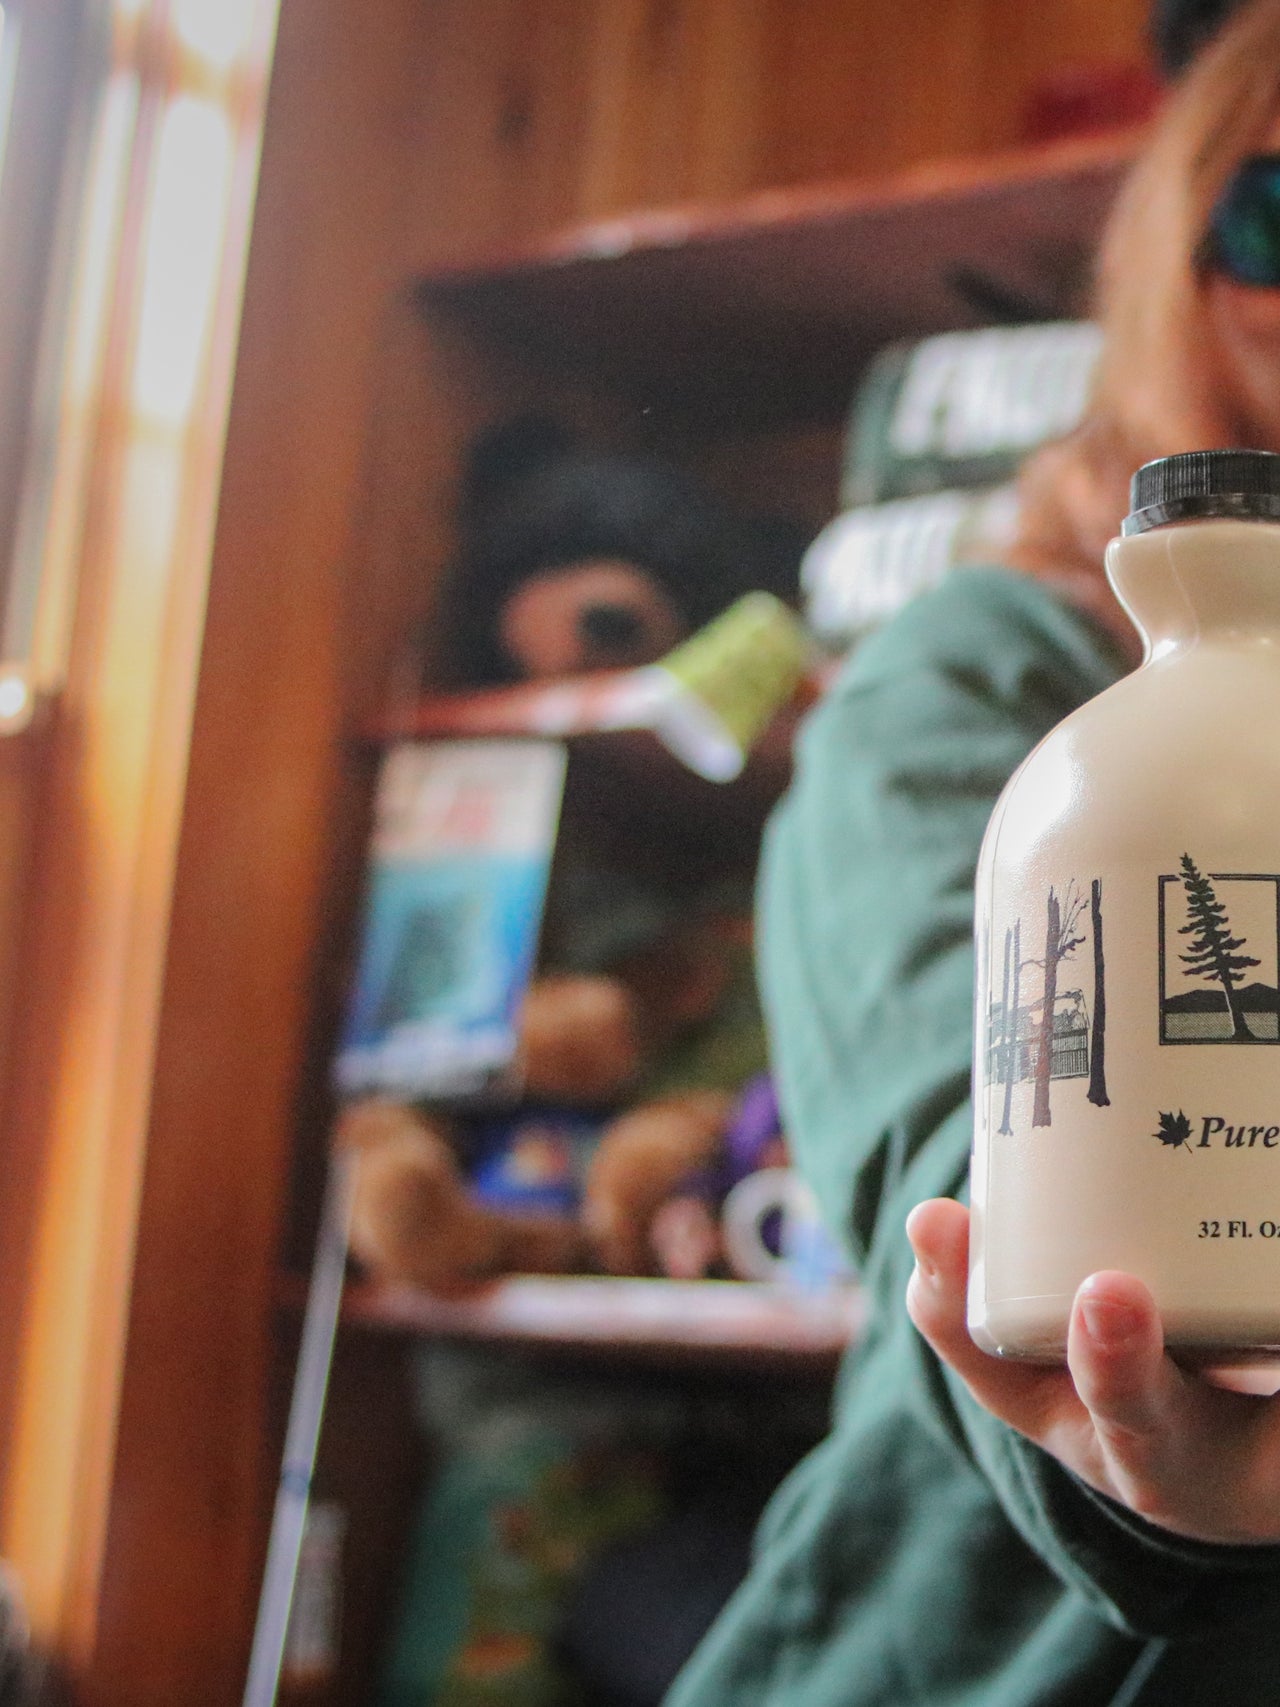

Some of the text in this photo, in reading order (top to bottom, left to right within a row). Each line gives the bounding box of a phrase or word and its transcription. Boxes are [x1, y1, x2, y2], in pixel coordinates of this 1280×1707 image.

[1197, 1116, 1280, 1148] Pure
[1198, 1221, 1221, 1239] 32
[1228, 1221, 1252, 1239] Fl.
